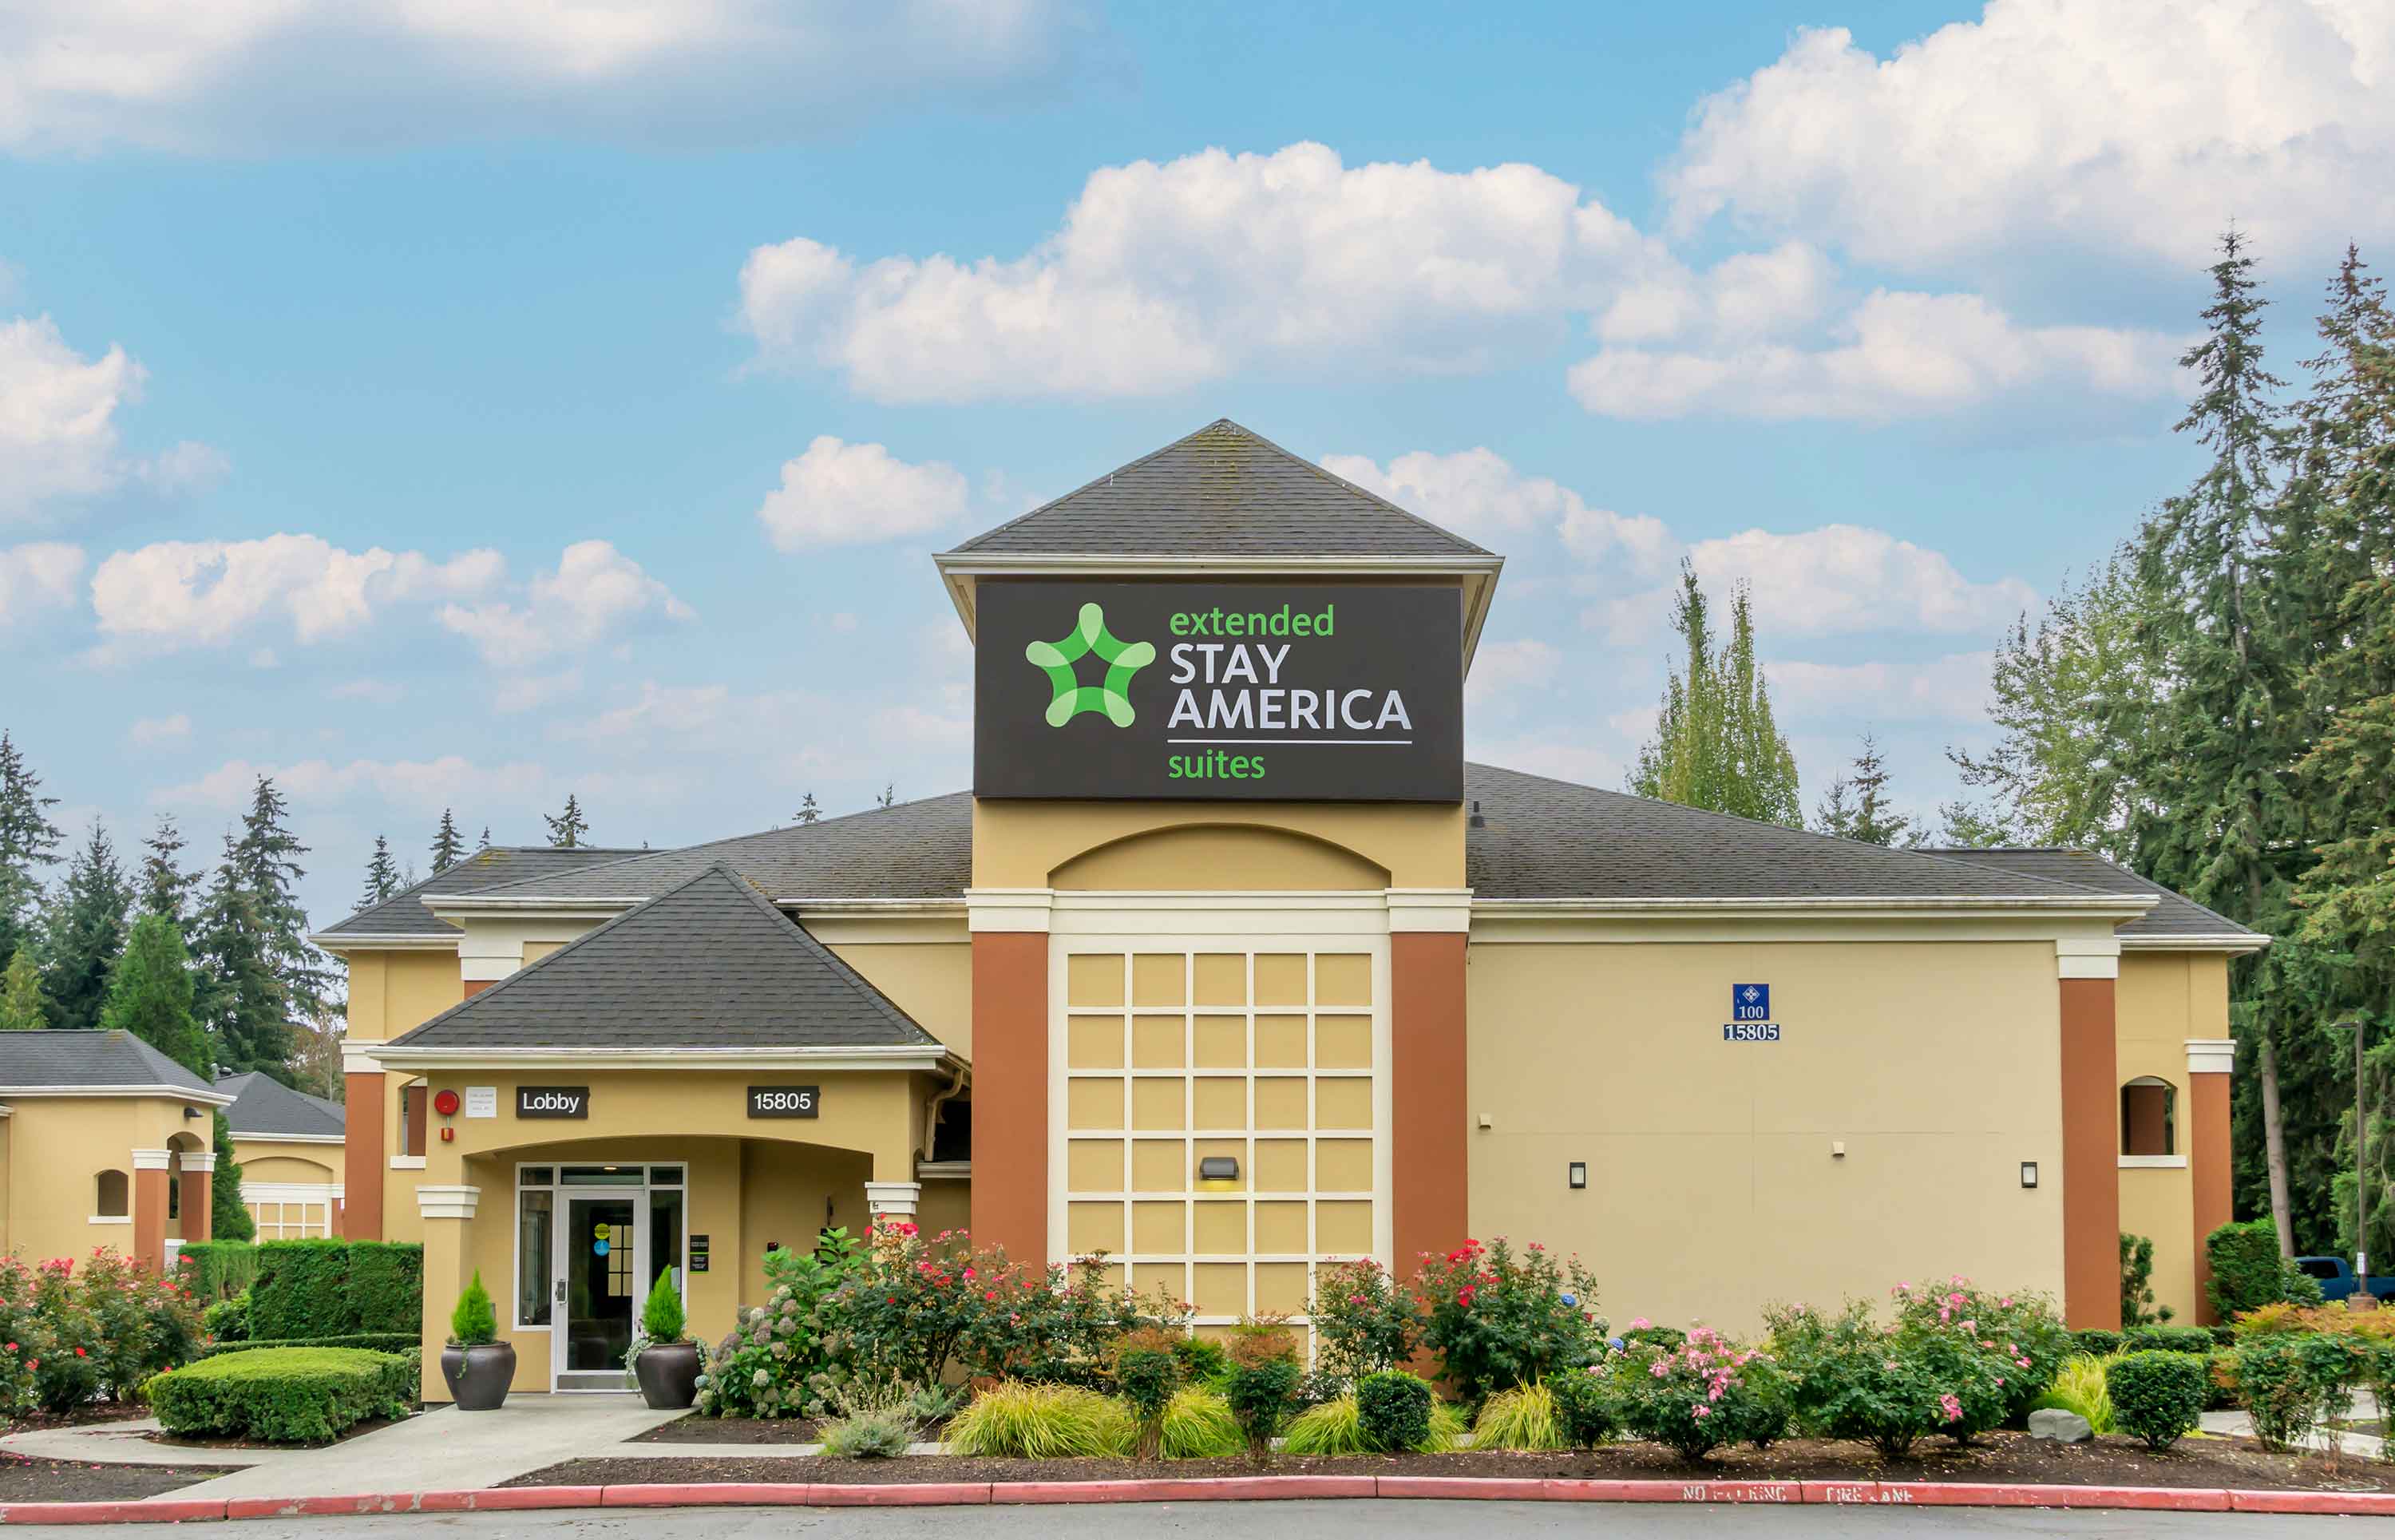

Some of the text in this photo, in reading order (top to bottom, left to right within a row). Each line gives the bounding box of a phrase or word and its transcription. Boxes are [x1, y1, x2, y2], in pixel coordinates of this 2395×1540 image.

[1169, 604, 1334, 637] extended
[1170, 643, 1291, 684] STAY
[1167, 689, 1413, 730] AMERICA
[1168, 749, 1266, 780] suites
[1739, 1005, 1764, 1019] 100
[1725, 1024, 1778, 1040] 15805
[523, 1092, 580, 1114] Lobby
[754, 1092, 811, 1110] 15805
[1683, 1486, 1706, 1501] NO
